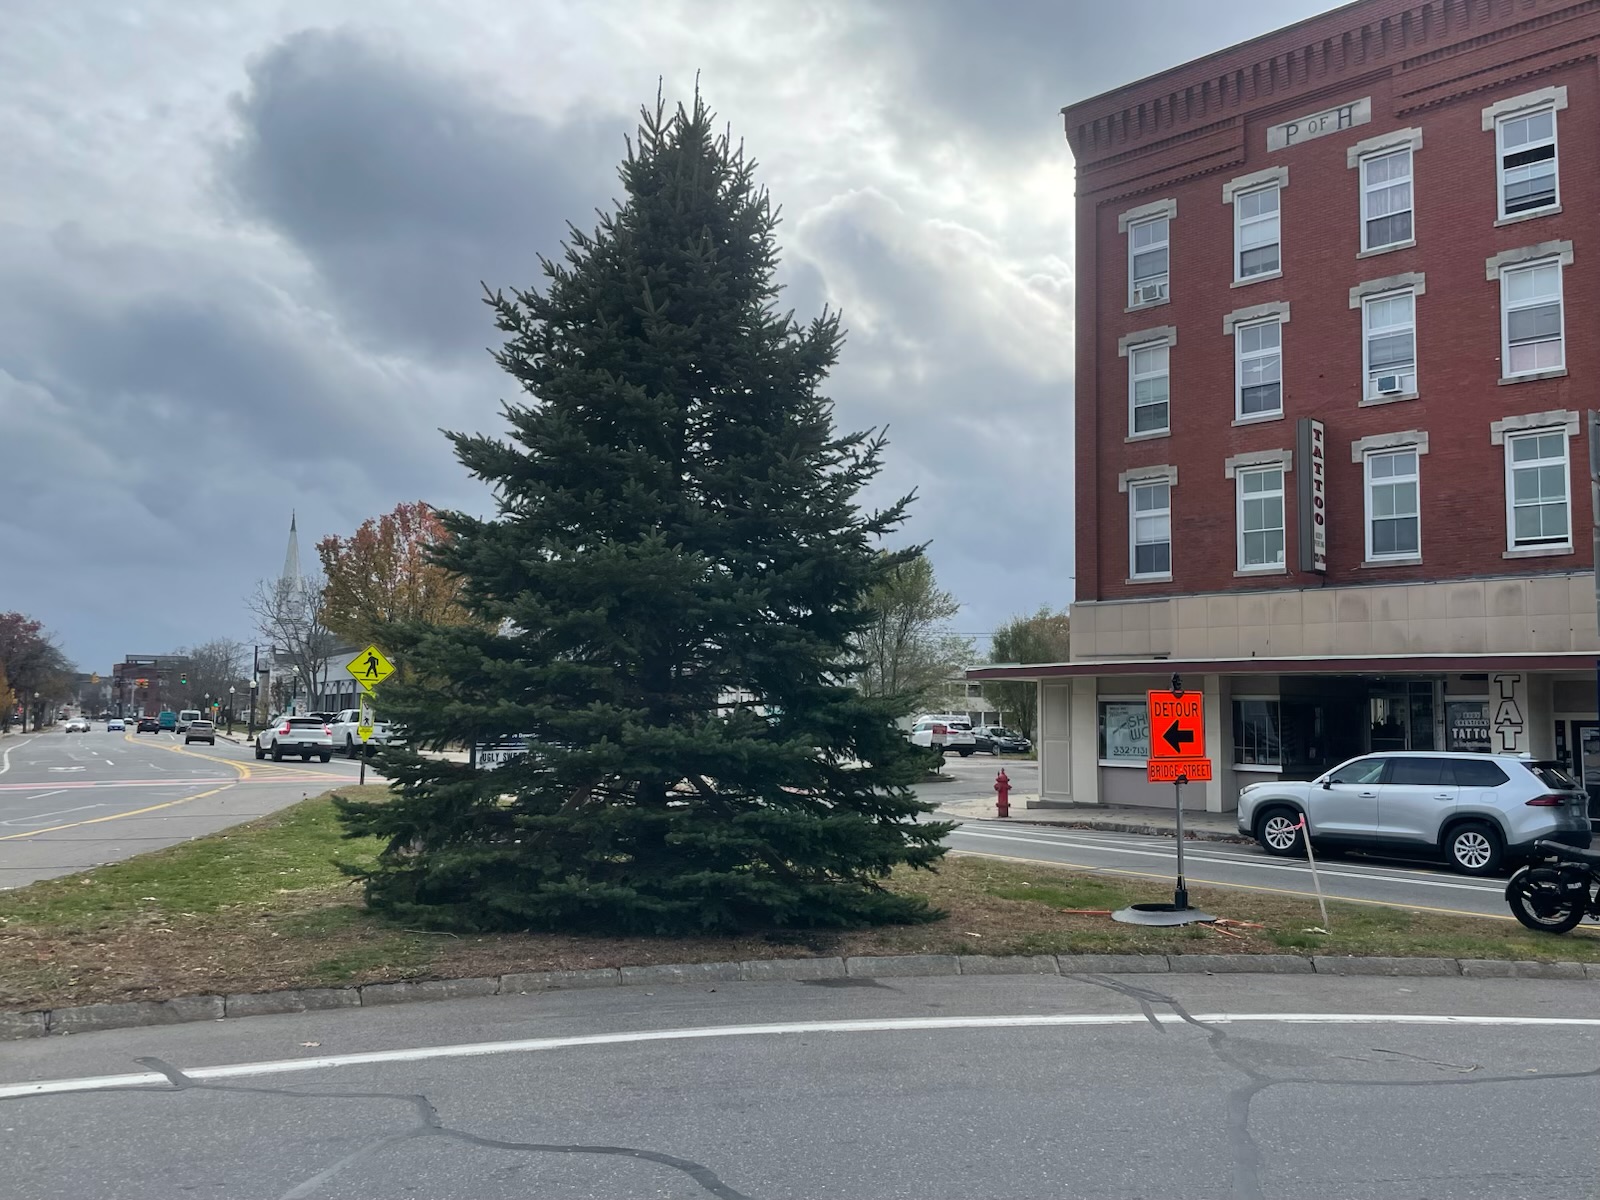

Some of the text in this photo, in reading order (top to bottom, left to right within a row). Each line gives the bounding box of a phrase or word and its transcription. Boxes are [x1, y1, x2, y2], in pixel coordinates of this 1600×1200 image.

[1285, 104, 1354, 146] P OF H
[1312, 428, 1324, 526] TATTOO
[1154, 702, 1199, 717] DETOUR
[1494, 674, 1524, 754] TAT
[1131, 726, 1148, 741] WO
[1452, 728, 1491, 739] TATTO
[483, 752, 499, 762] UGLY
[1150, 763, 1210, 778] BRIDGE STREET
